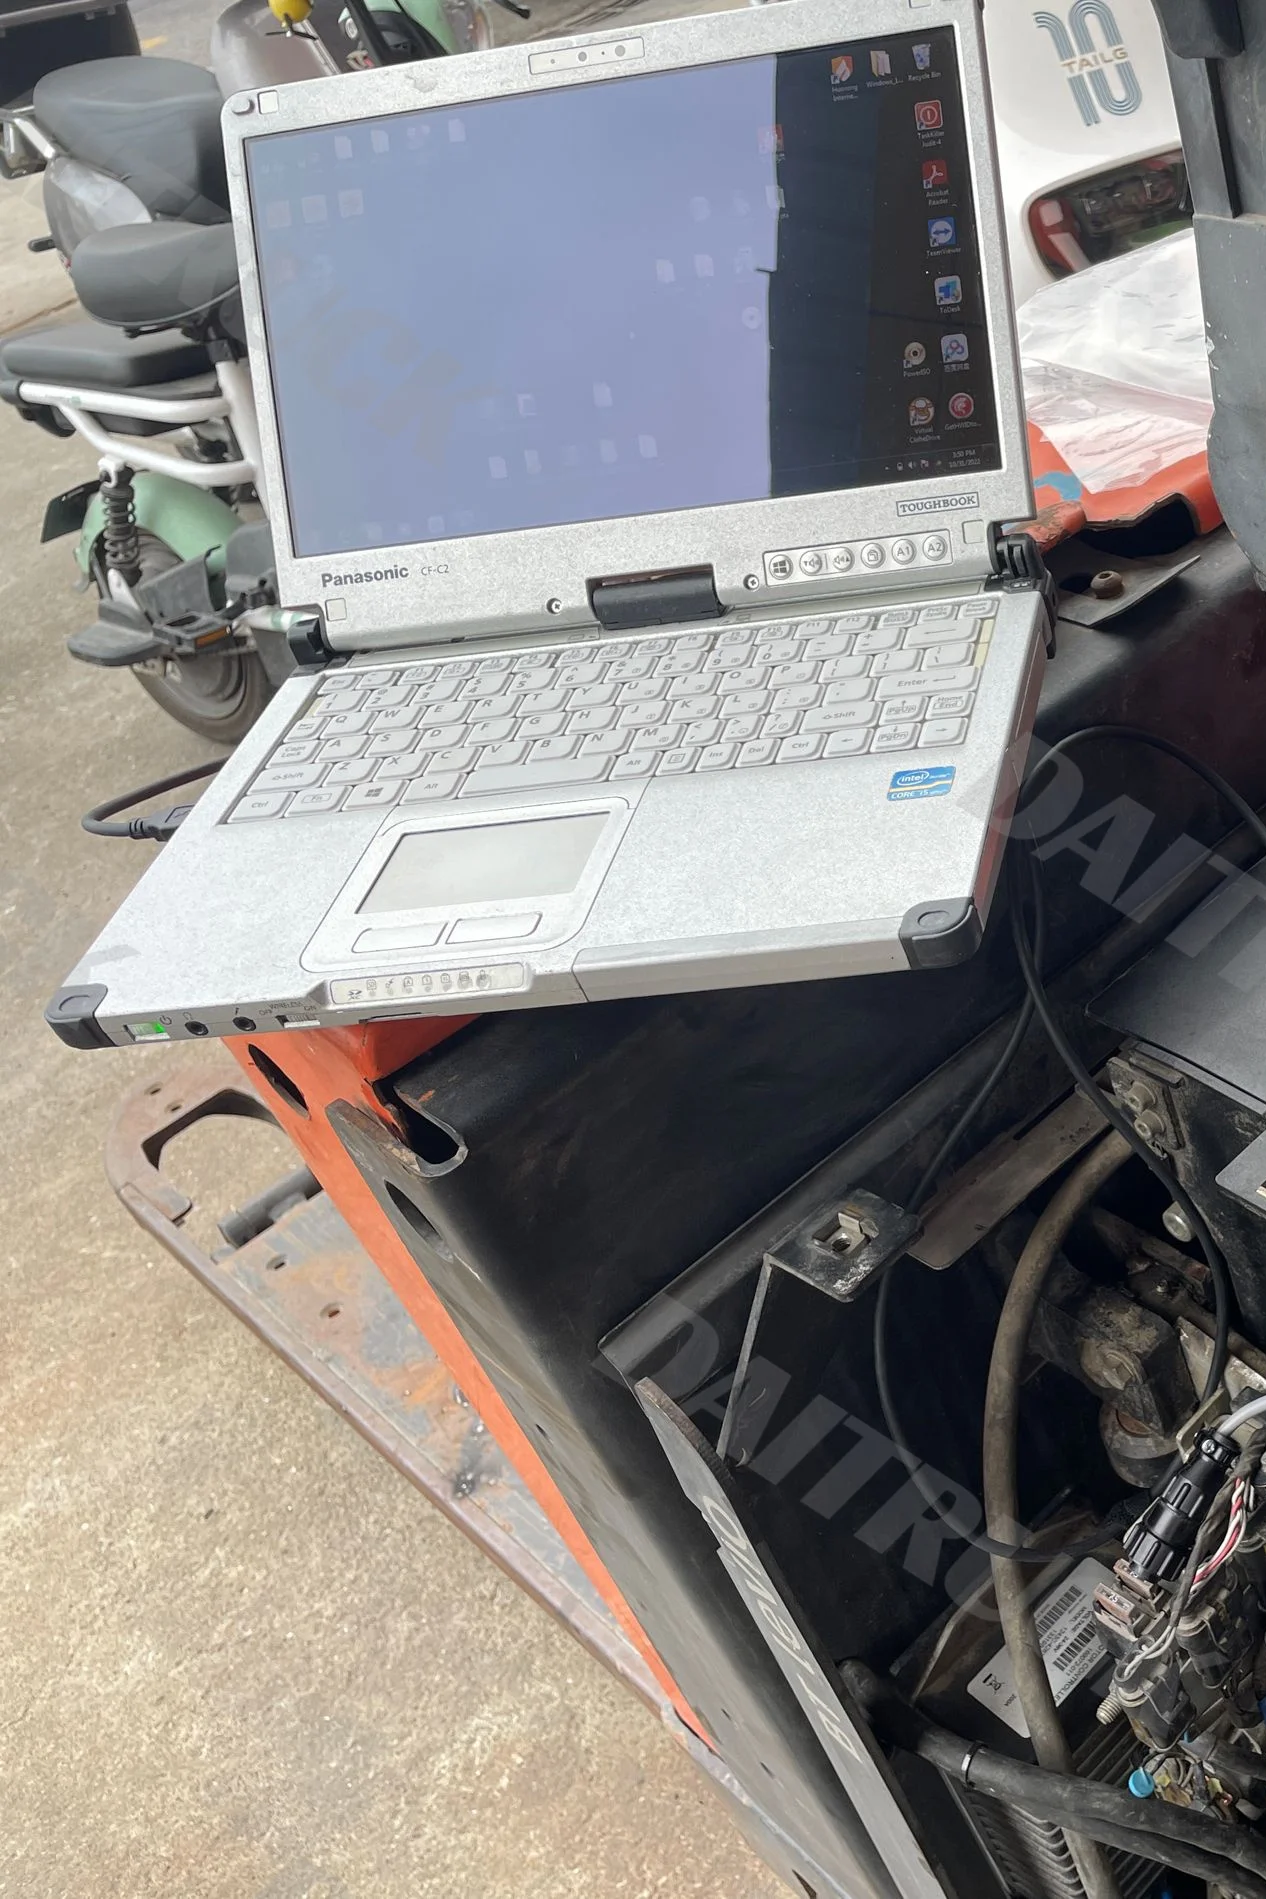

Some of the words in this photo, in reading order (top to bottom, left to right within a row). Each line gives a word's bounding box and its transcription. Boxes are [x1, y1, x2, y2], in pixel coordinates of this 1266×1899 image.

[1061, 47, 1129, 74] TAILG
[899, 496, 977, 513] TOUGHBOOK
[927, 542, 942, 552] A2
[321, 565, 409, 588] Panasonic
[420, 564, 450, 576] CF-C2
[897, 678, 927, 687] Enter
[1055, 1663, 1089, 1701] CONTROLLE
